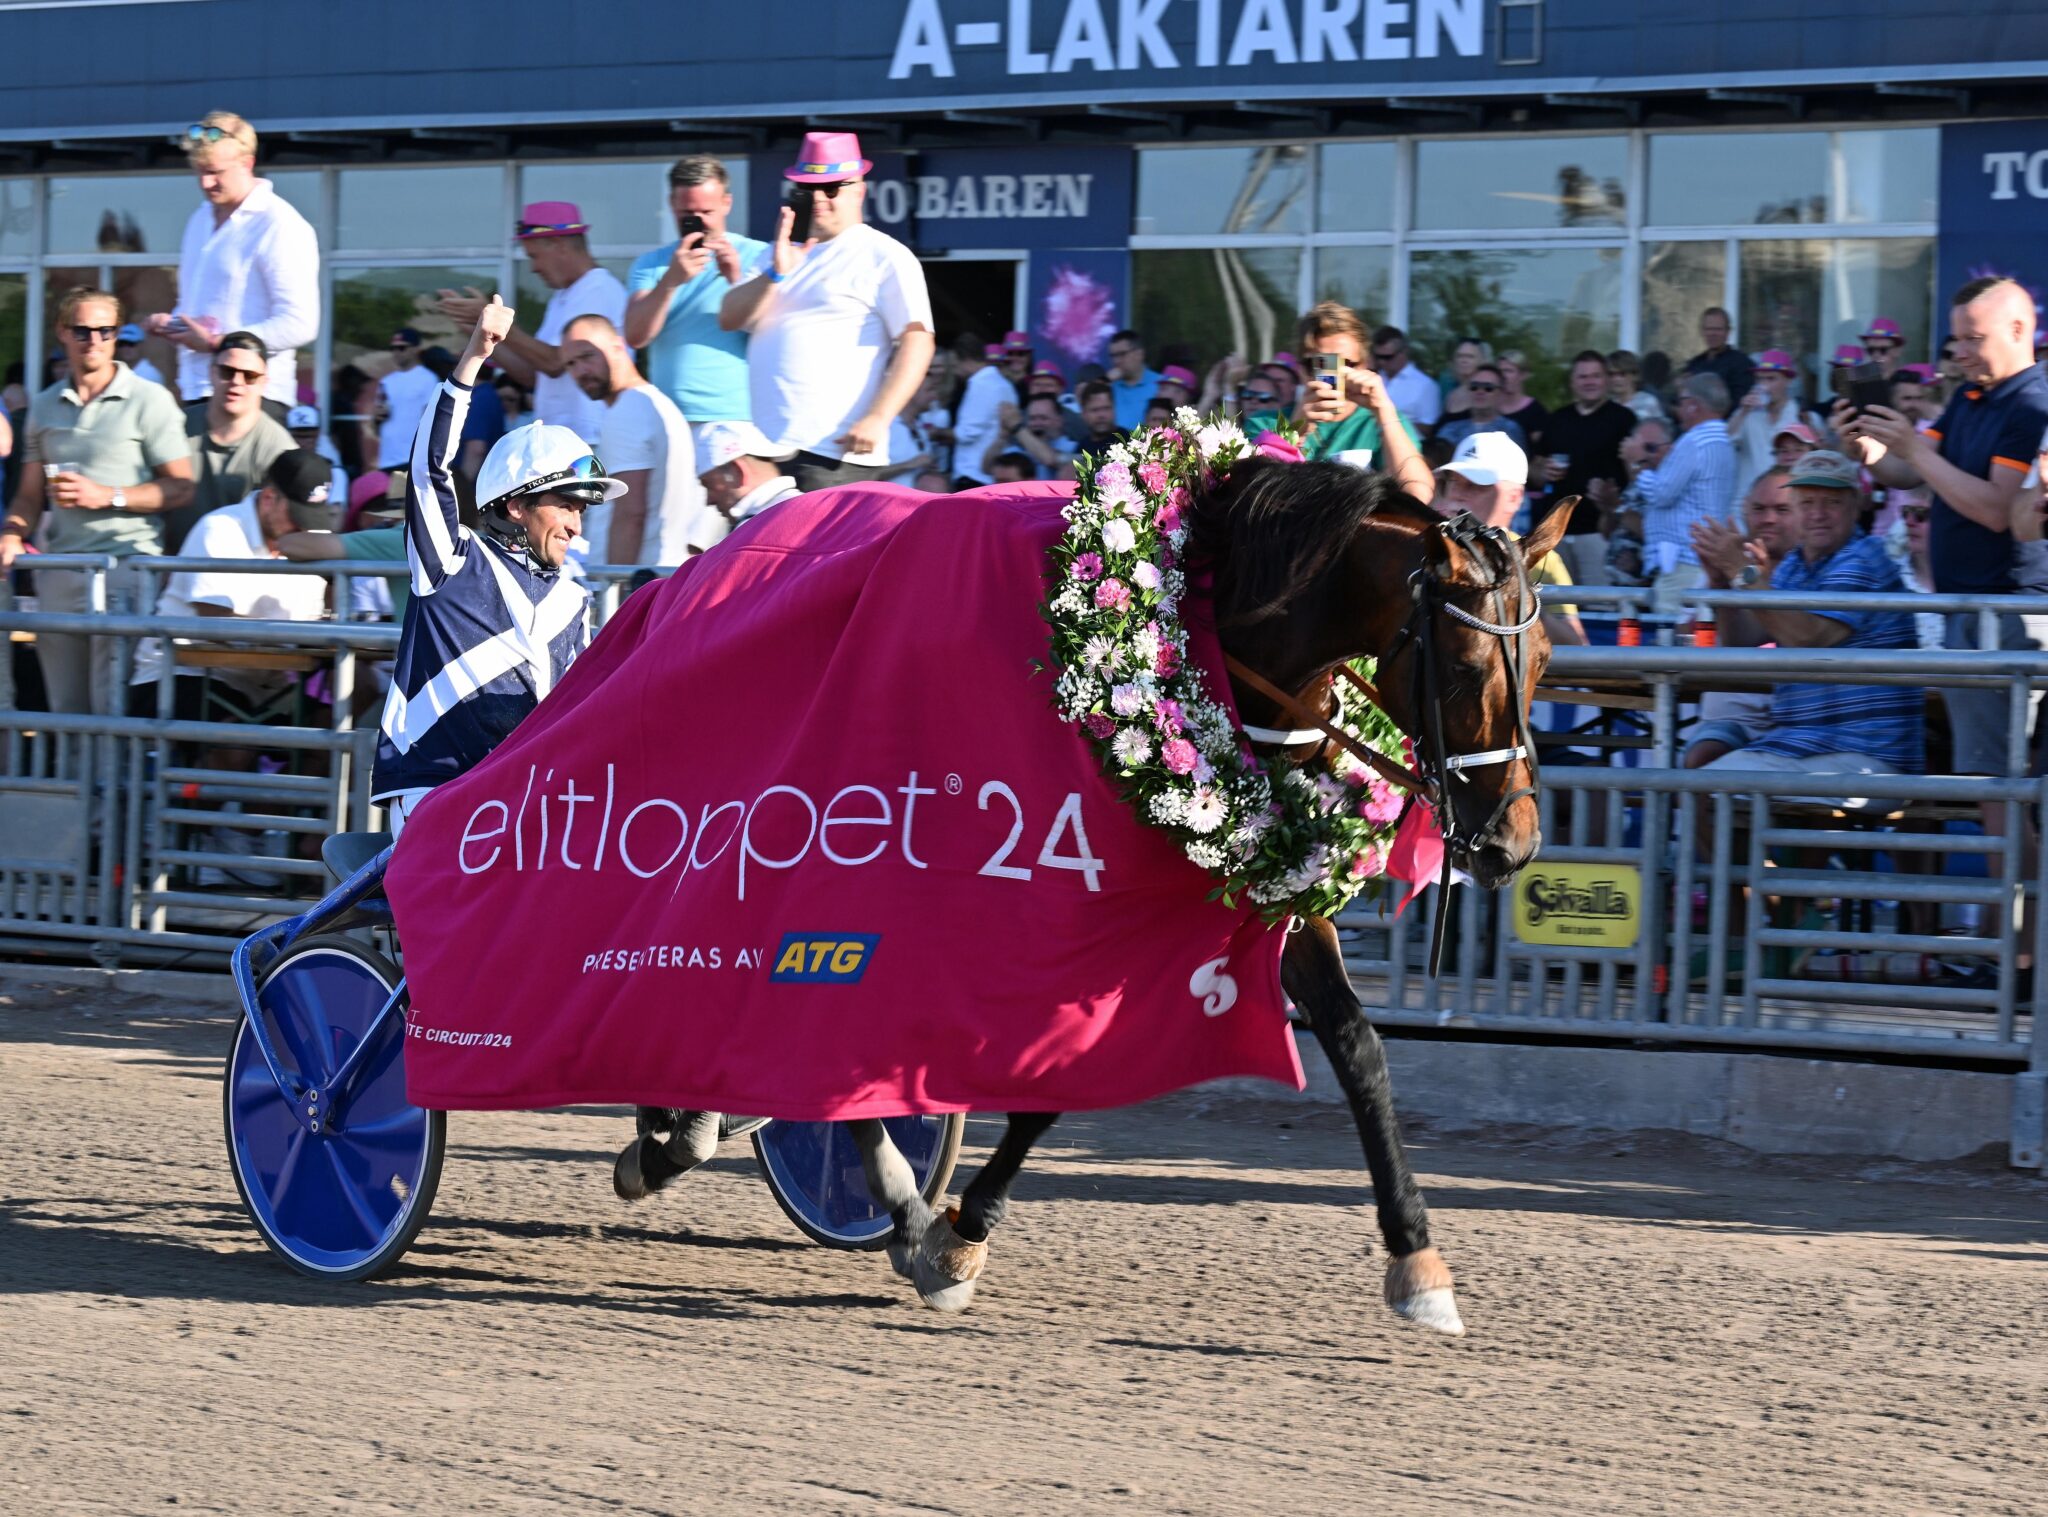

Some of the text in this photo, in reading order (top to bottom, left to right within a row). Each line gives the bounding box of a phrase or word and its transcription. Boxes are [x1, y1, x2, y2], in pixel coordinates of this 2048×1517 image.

[976, 779, 1106, 892] 24
[734, 947, 764, 970] AV
[775, 941, 865, 974] ATG
